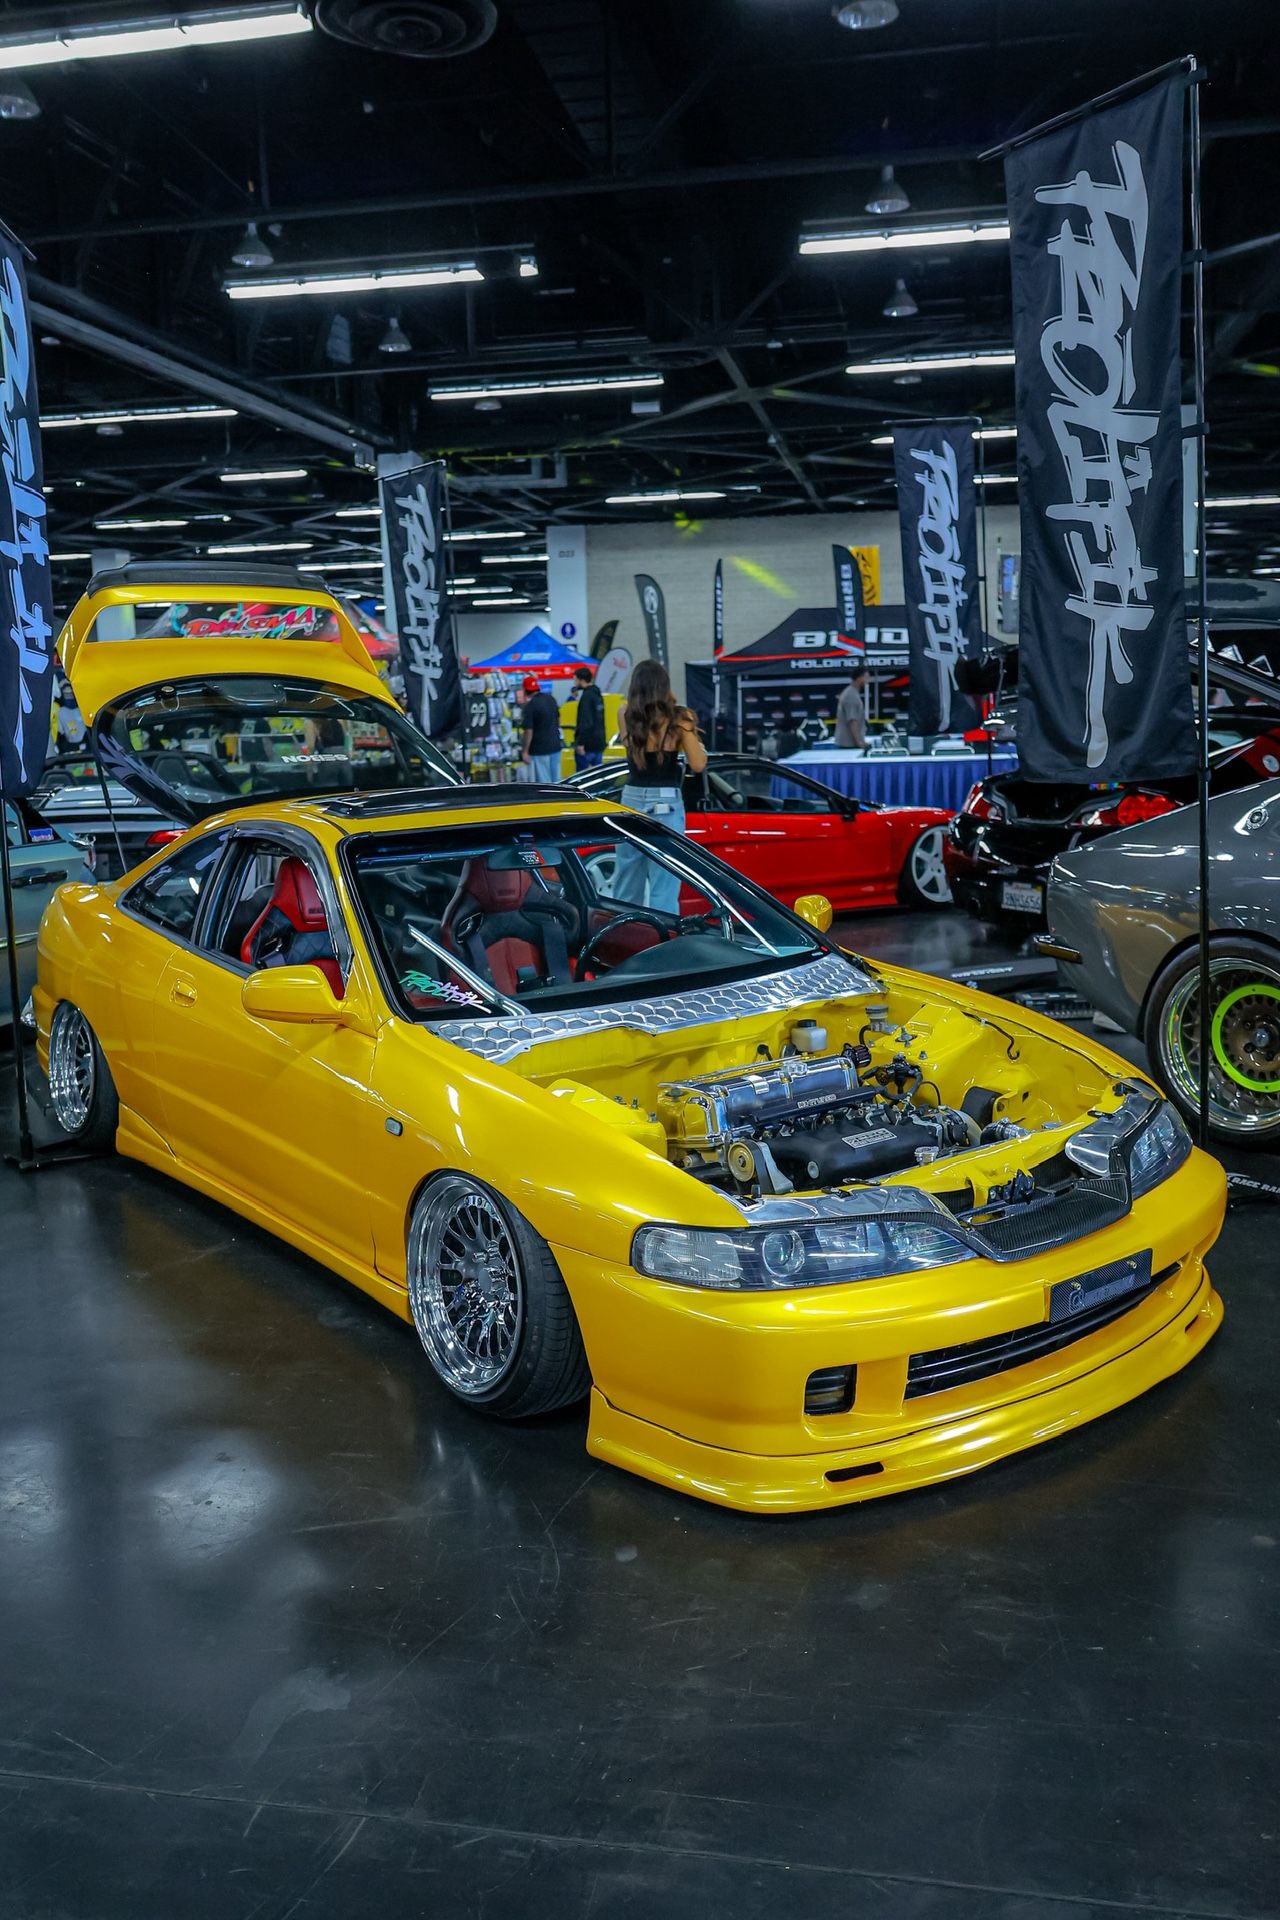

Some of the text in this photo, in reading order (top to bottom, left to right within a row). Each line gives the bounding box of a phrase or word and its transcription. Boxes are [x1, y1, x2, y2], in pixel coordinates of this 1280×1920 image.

[840, 563, 857, 631] BRIDE
[791, 626, 910, 649] BID
[790, 655, 910, 669] HOLDING MONS
[1231, 1177, 1261, 1189] RACE
